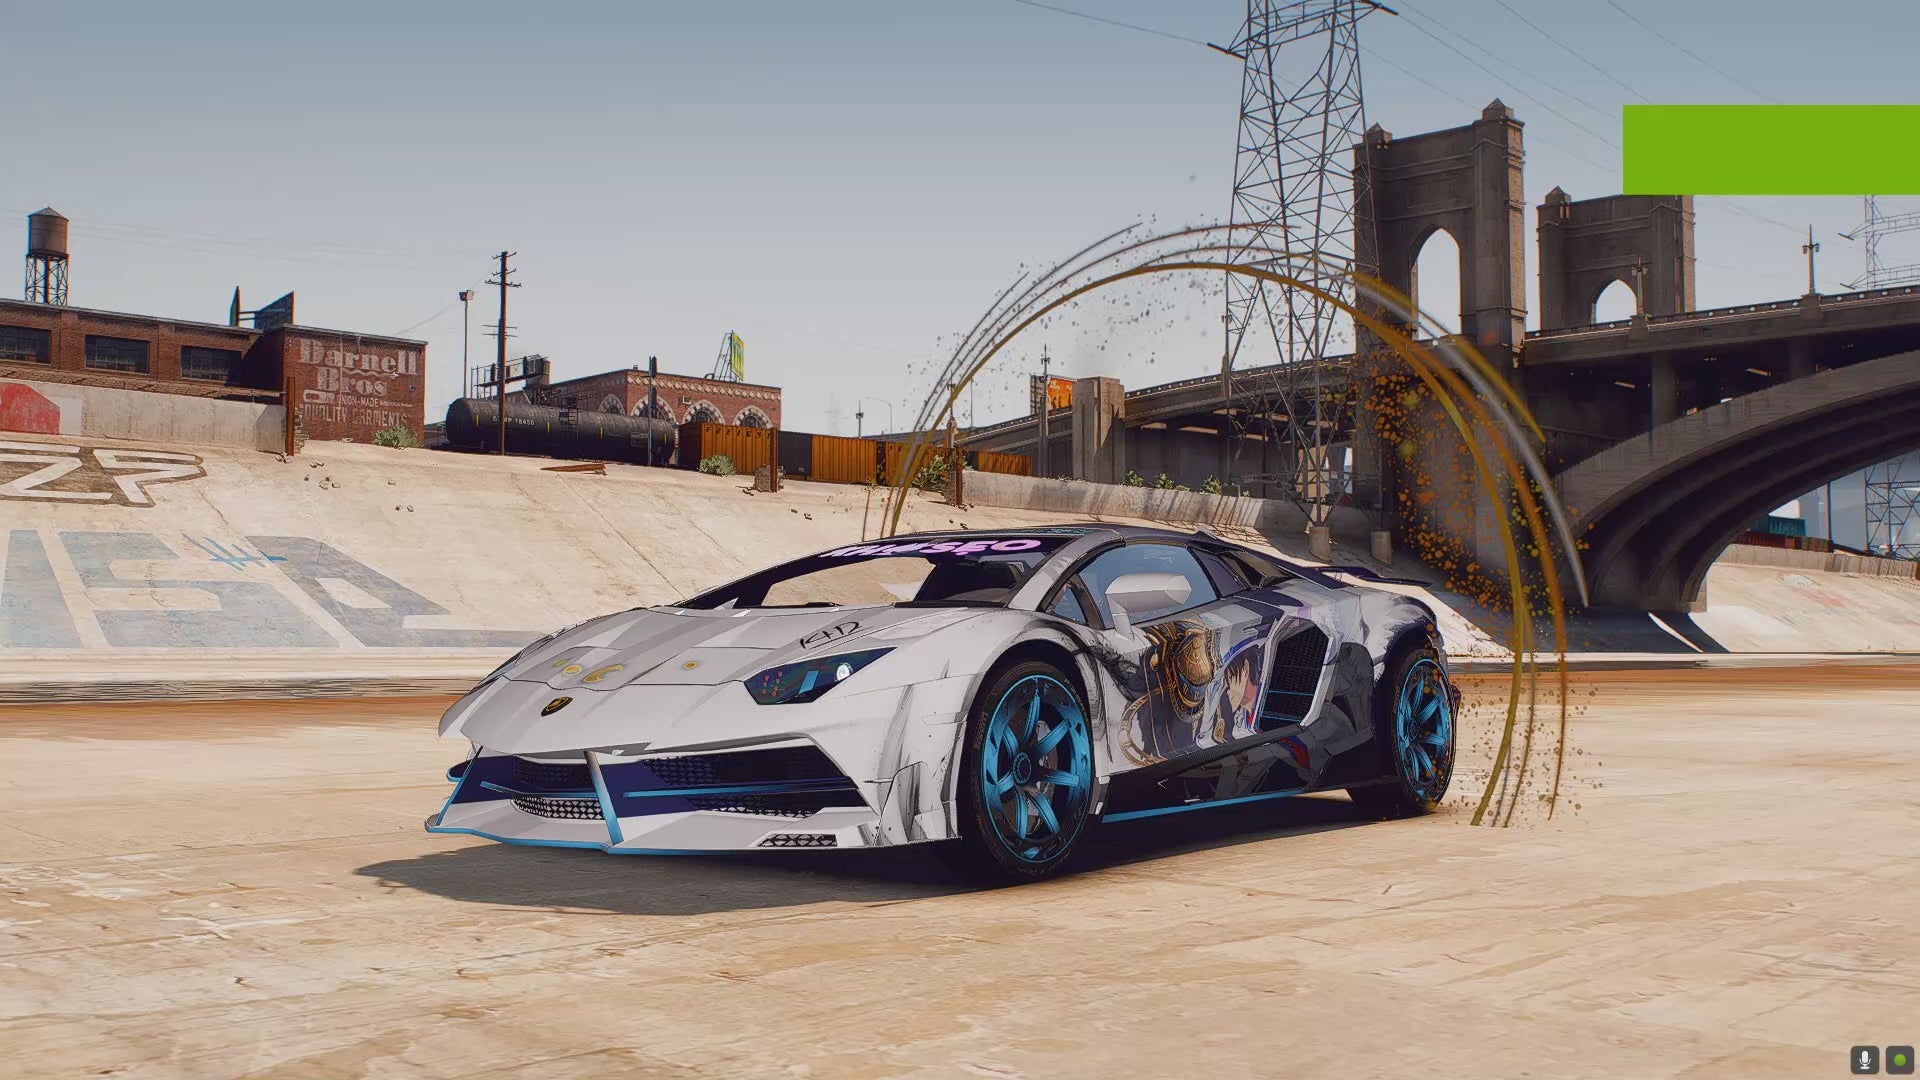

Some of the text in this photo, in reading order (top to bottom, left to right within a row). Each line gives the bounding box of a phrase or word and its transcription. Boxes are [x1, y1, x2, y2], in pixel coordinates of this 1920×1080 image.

[299, 338, 418, 375] Darnell
[316, 366, 388, 396] Bros
[304, 403, 348, 423] QUALITY
[352, 408, 408, 427] GARMENTS
